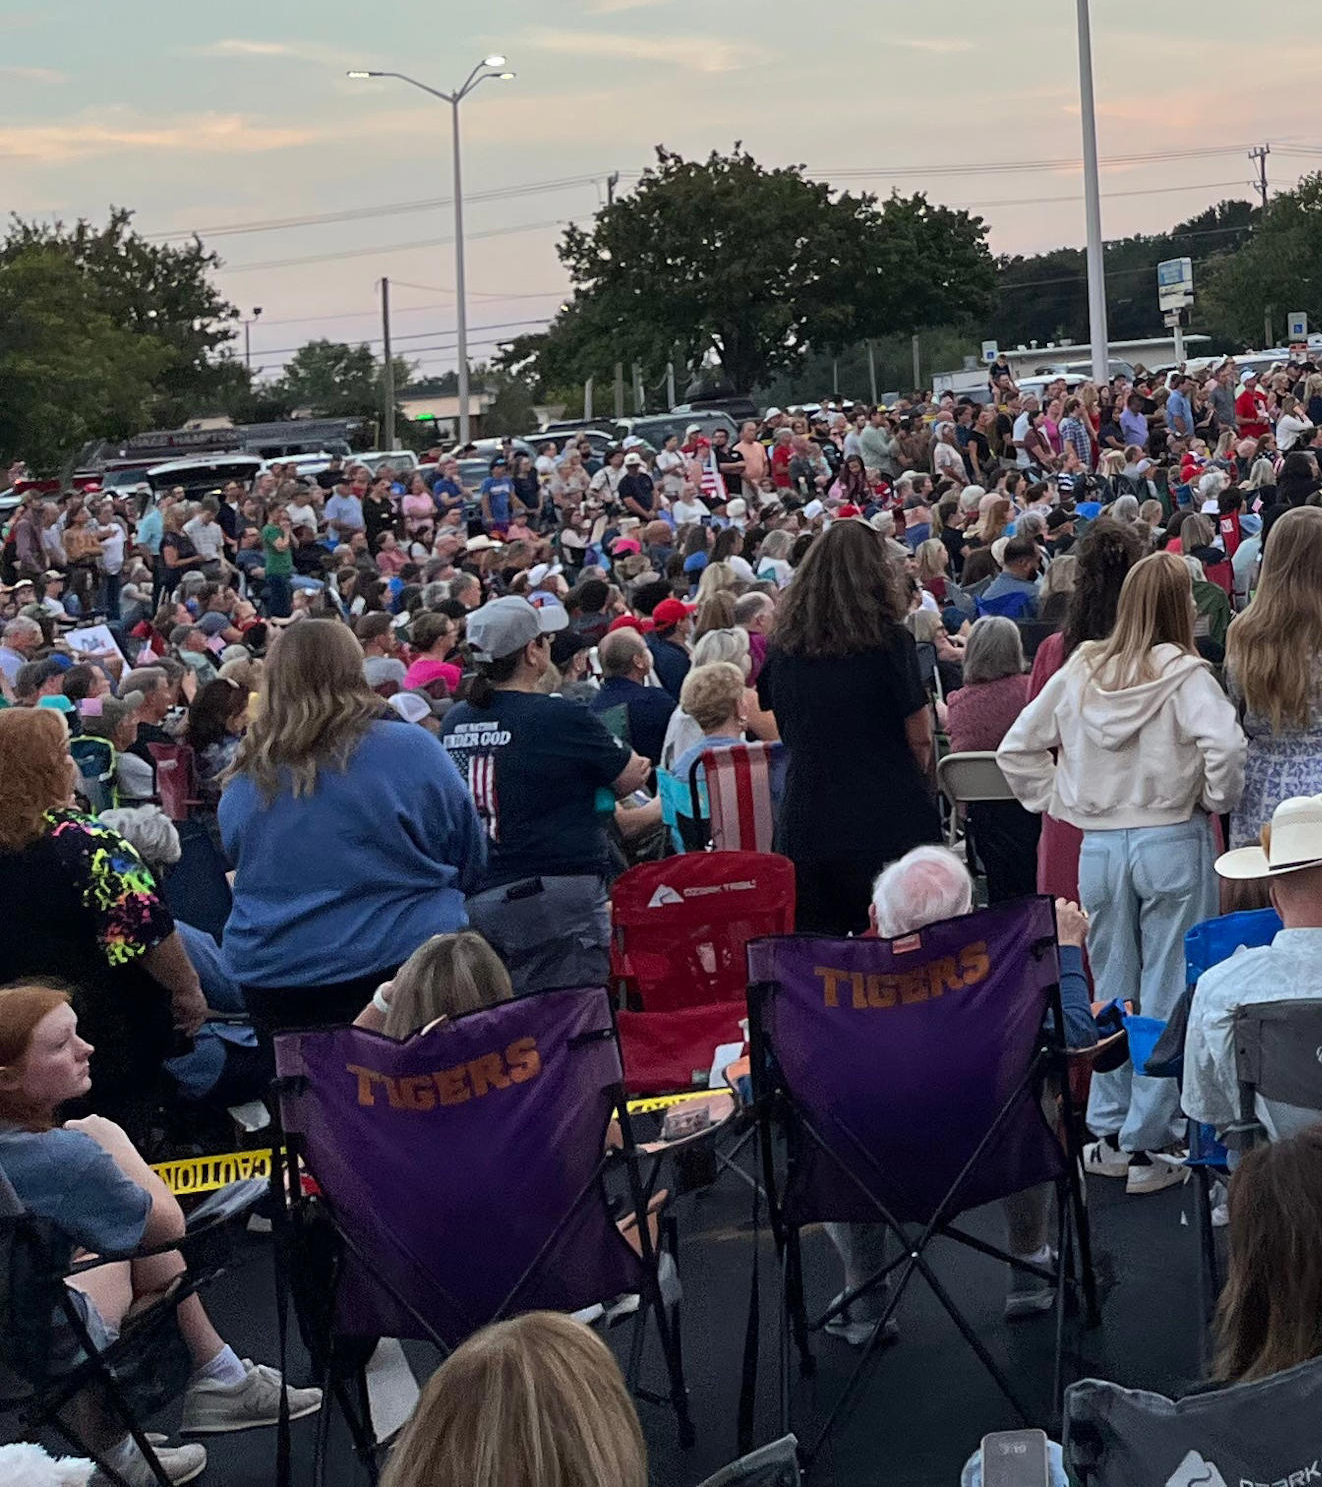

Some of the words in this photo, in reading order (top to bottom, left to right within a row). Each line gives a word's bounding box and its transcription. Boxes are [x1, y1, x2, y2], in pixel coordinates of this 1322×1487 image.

[443, 733, 479, 749] UNDER
[480, 730, 511, 746] GOD
[814, 941, 991, 1010] TIGERS
[346, 1037, 541, 1111] TIGERS
